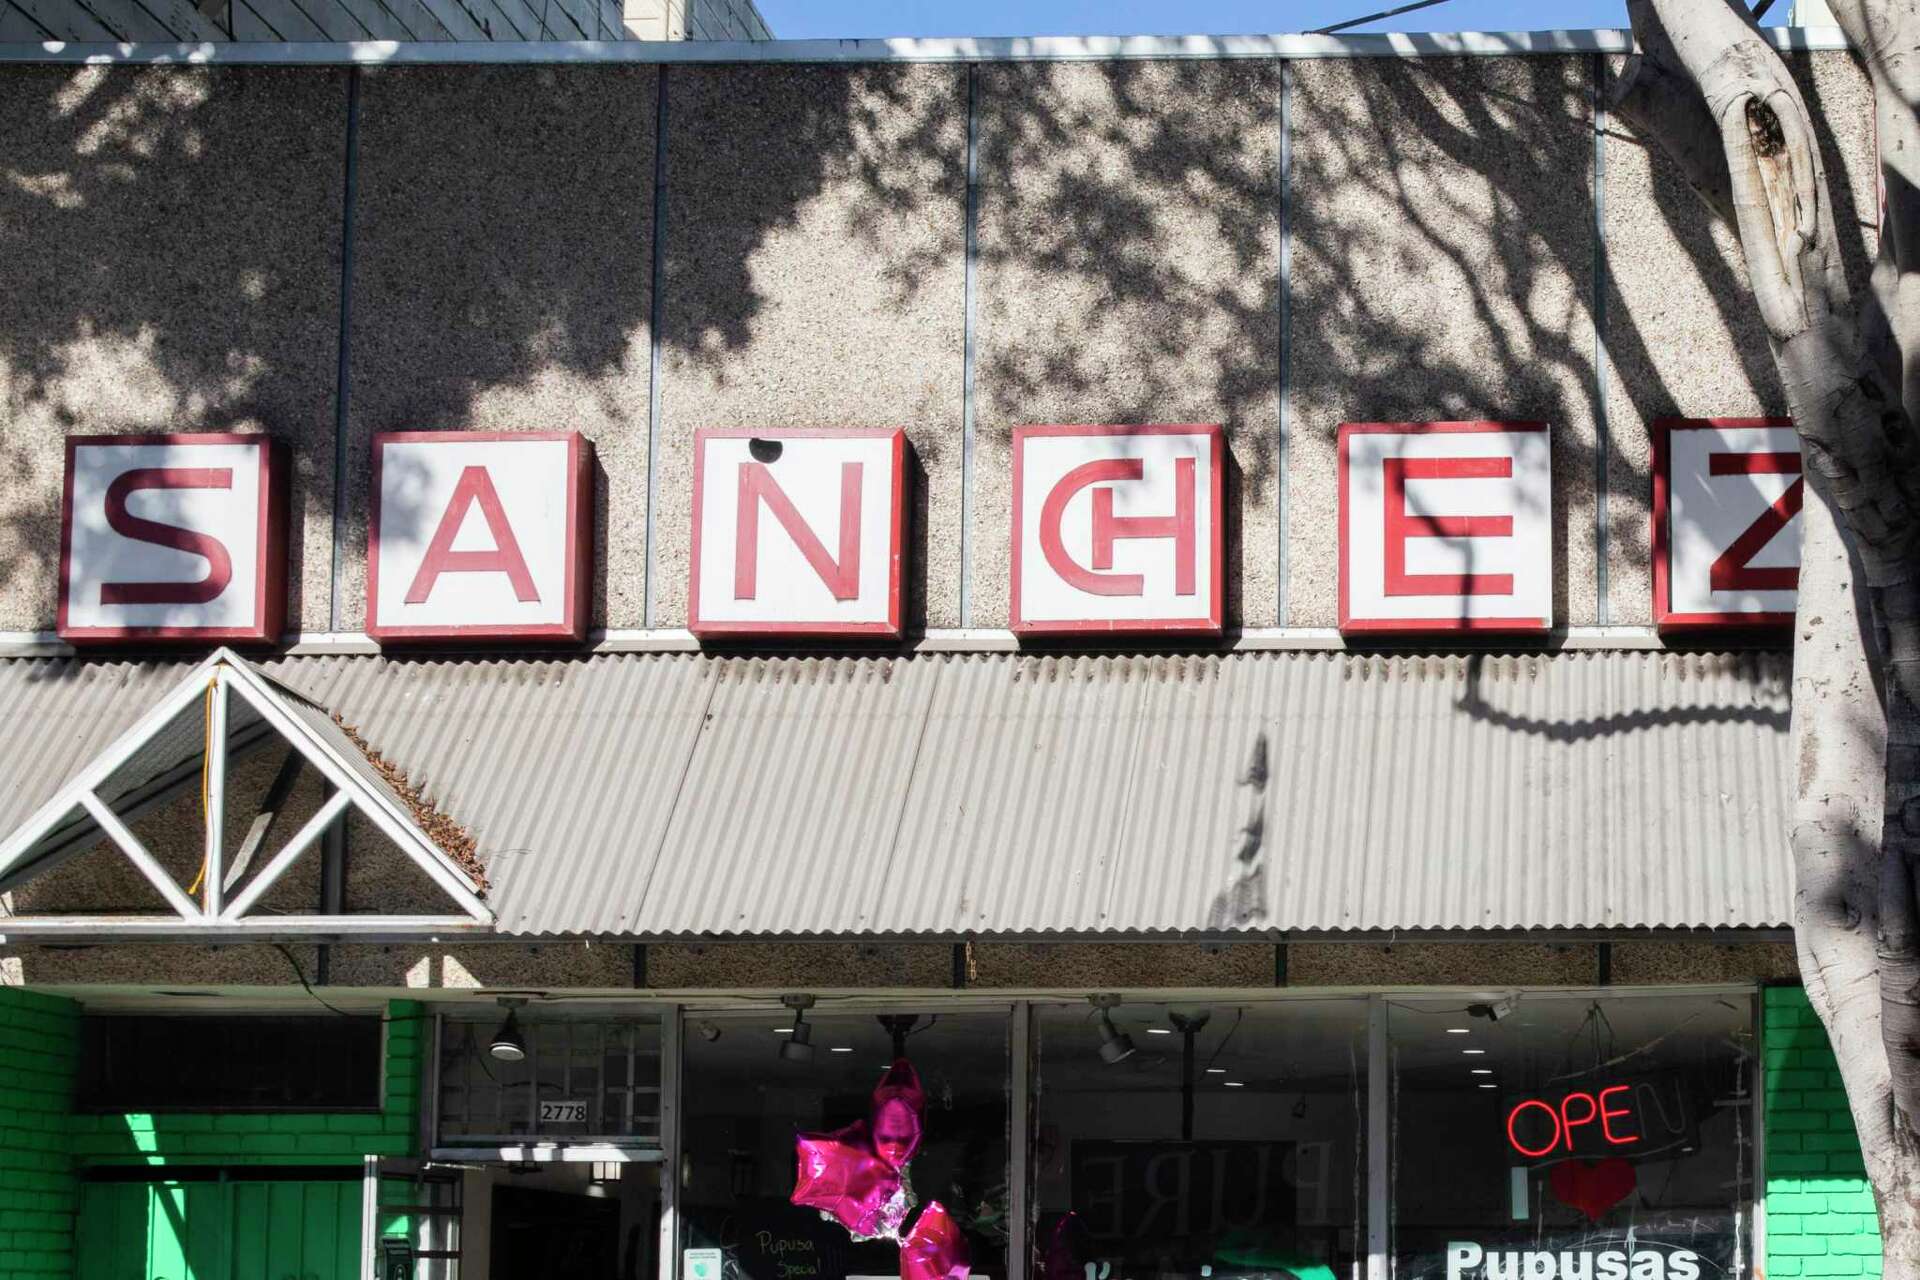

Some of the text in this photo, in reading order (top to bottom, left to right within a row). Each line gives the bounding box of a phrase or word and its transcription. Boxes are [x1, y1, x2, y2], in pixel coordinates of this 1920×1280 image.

[542, 1105, 585, 1121] 2778
[1506, 1080, 1686, 1157] OPEN
[1447, 1241, 1700, 1280] Pupusas
